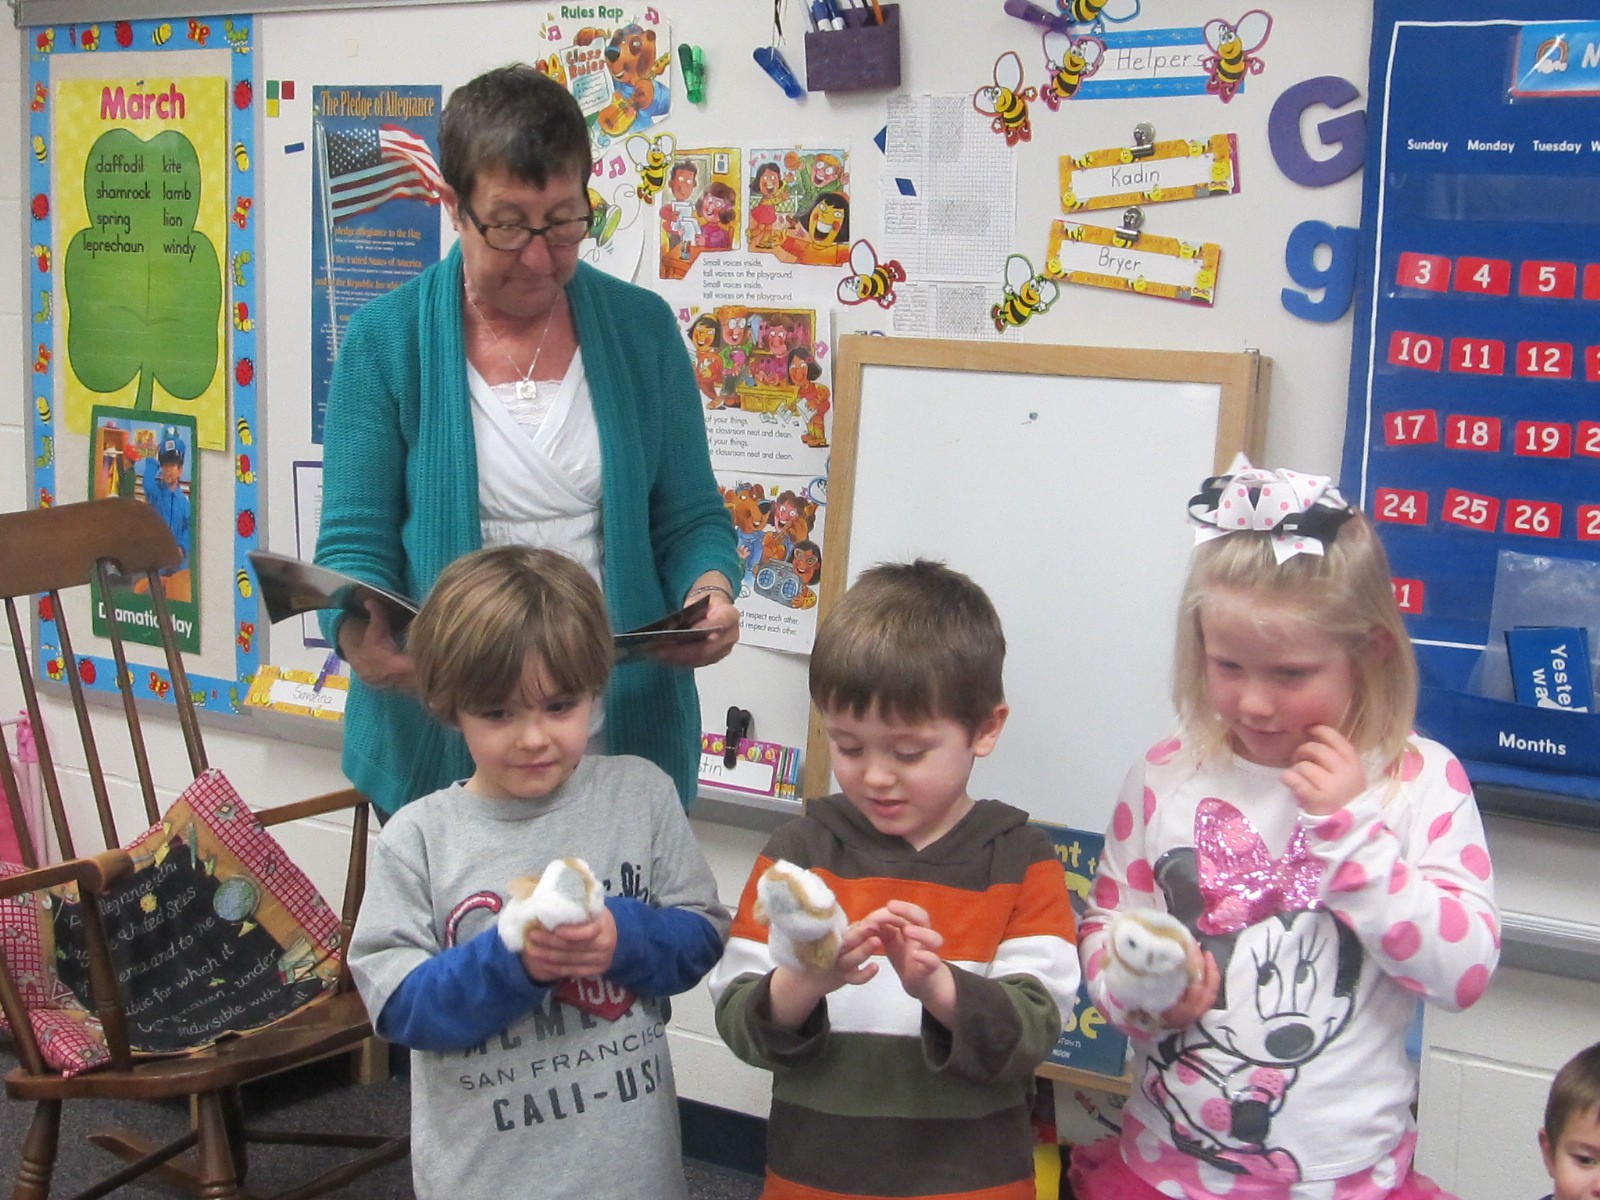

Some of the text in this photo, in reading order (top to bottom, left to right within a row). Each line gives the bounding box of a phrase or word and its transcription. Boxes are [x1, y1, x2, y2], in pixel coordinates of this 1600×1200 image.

[560, 5, 624, 23] Rules Rap
[1117, 47, 1206, 77] Helpers
[1582, 43, 1600, 69] M
[100, 83, 185, 121] March
[320, 90, 434, 121] The Pledge of Allegiance
[1268, 75, 1366, 190] G
[1407, 139, 1449, 153] Sunday
[1467, 140, 1515, 154] Monday
[1533, 140, 1582, 154] Tuesday
[96, 154, 183, 173] daffodil kite
[1111, 163, 1160, 188] Kadin
[96, 181, 192, 200] shamrock lamb
[97, 208, 183, 234] spring lion
[83, 234, 196, 262] leprechaun windy
[1099, 247, 1142, 274] Bryer
[703, 258, 720, 267] Small
[715, 269, 735, 278] voices
[736, 271, 745, 279] on
[746, 270, 755, 279] the
[1281, 219, 1360, 323] g
[703, 280, 720, 289] Small
[722, 282, 742, 290] voices
[1414, 260, 1557, 292] 3 4 5
[715, 292, 735, 300] voices
[746, 292, 755, 301] the
[1398, 336, 1561, 373] 10 11 12
[713, 417, 728, 425] your
[715, 427, 746, 436] classroom
[747, 429, 761, 437] neat
[762, 430, 774, 438] and
[1393, 415, 1600, 452] 17 18 19 2
[713, 438, 728, 446] your
[715, 448, 746, 458] classroom
[747, 450, 761, 459] neat
[762, 452, 774, 460] and
[1383, 493, 1600, 535] 24 25 26 2
[98, 602, 193, 639] Damatic lay
[745, 622, 766, 632] respect
[746, 611, 767, 621] respect
[768, 615, 782, 623] each
[1498, 730, 1567, 756] Months
[152, 986, 172, 1004] for
[176, 957, 222, 990] which
[221, 942, 235, 961] it
[234, 948, 276, 989] under
[459, 1066, 516, 1092] SAN
[531, 1021, 666, 1080] FRANCISC
